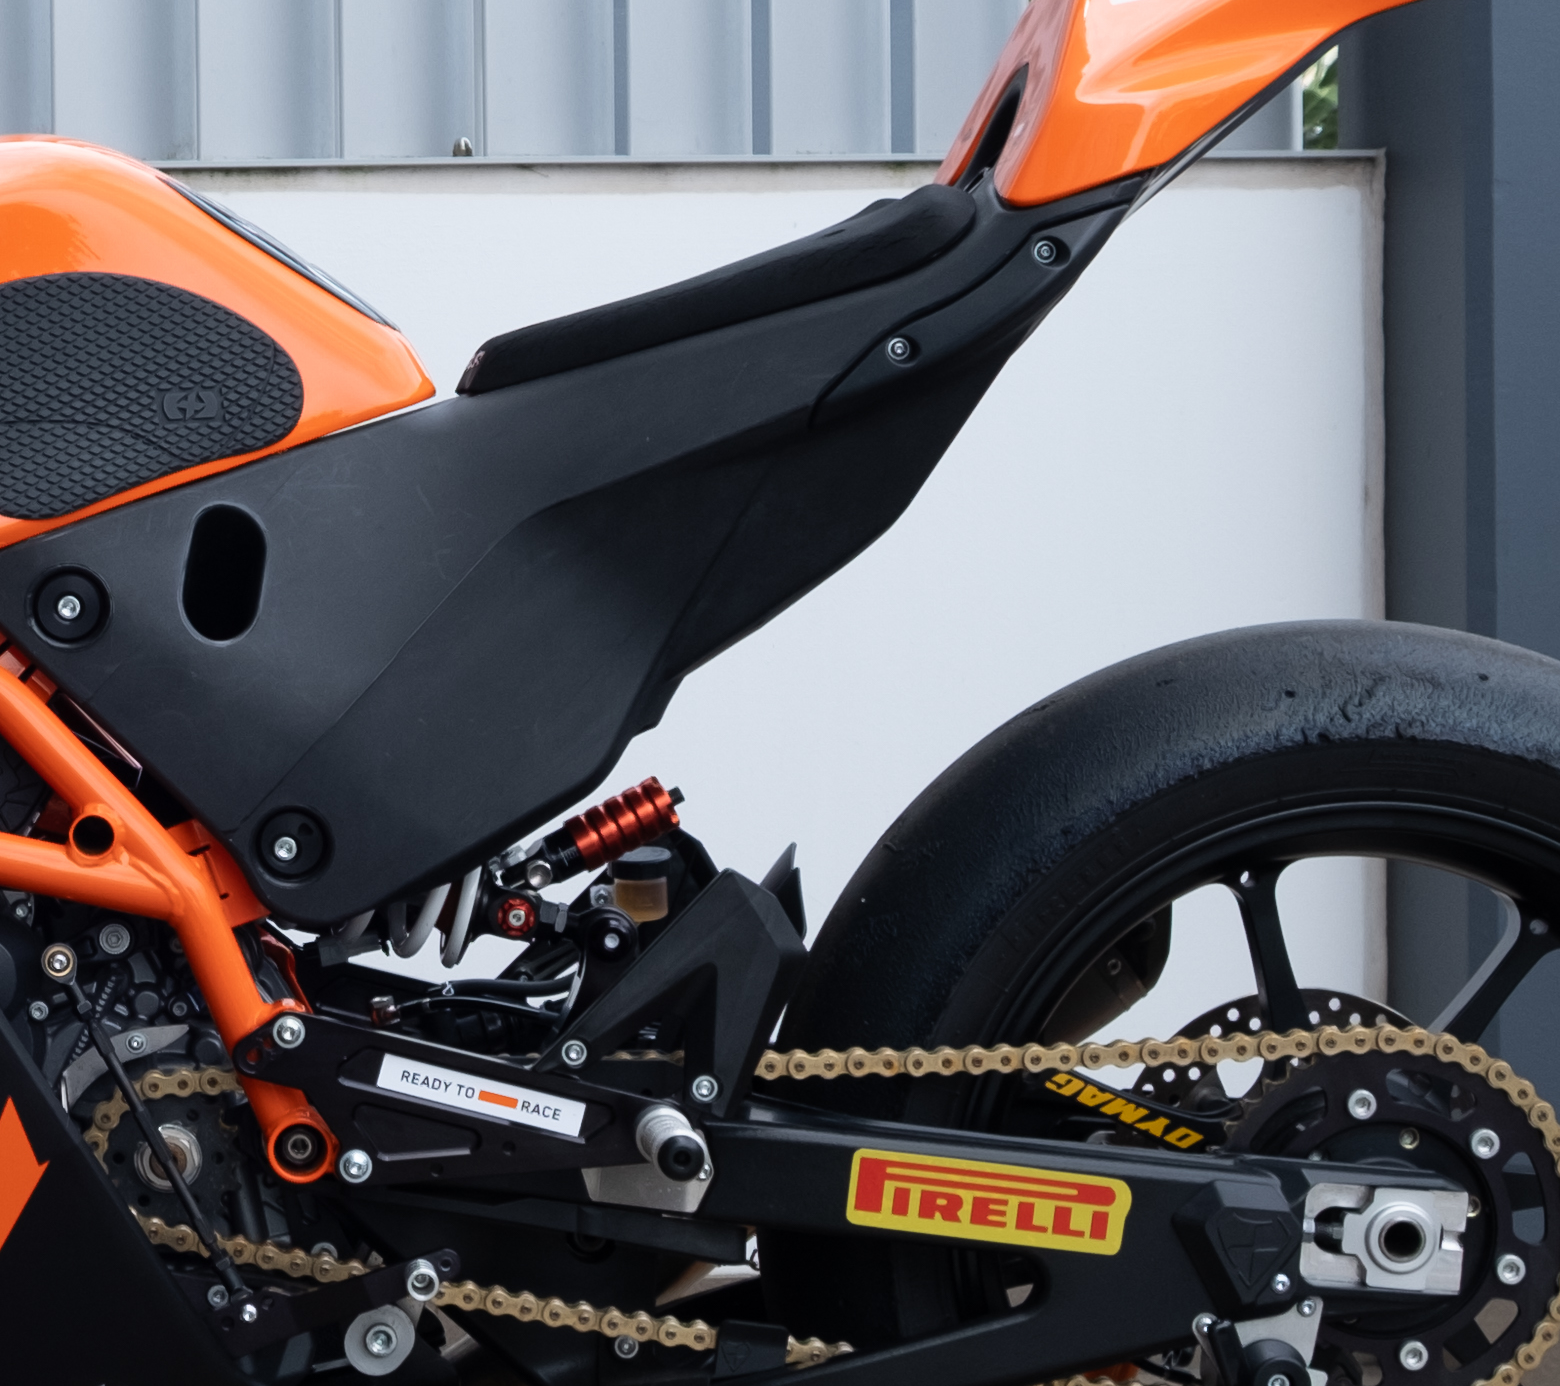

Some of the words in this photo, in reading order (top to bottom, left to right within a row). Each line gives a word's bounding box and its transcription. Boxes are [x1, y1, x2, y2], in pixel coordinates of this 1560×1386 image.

[400, 1070, 453, 1094] READY
[456, 1084, 475, 1099] TO
[521, 1100, 562, 1121] RACE
[1044, 1073, 1204, 1149] DYMAG
[854, 1157, 1116, 1241] PIRELLI
